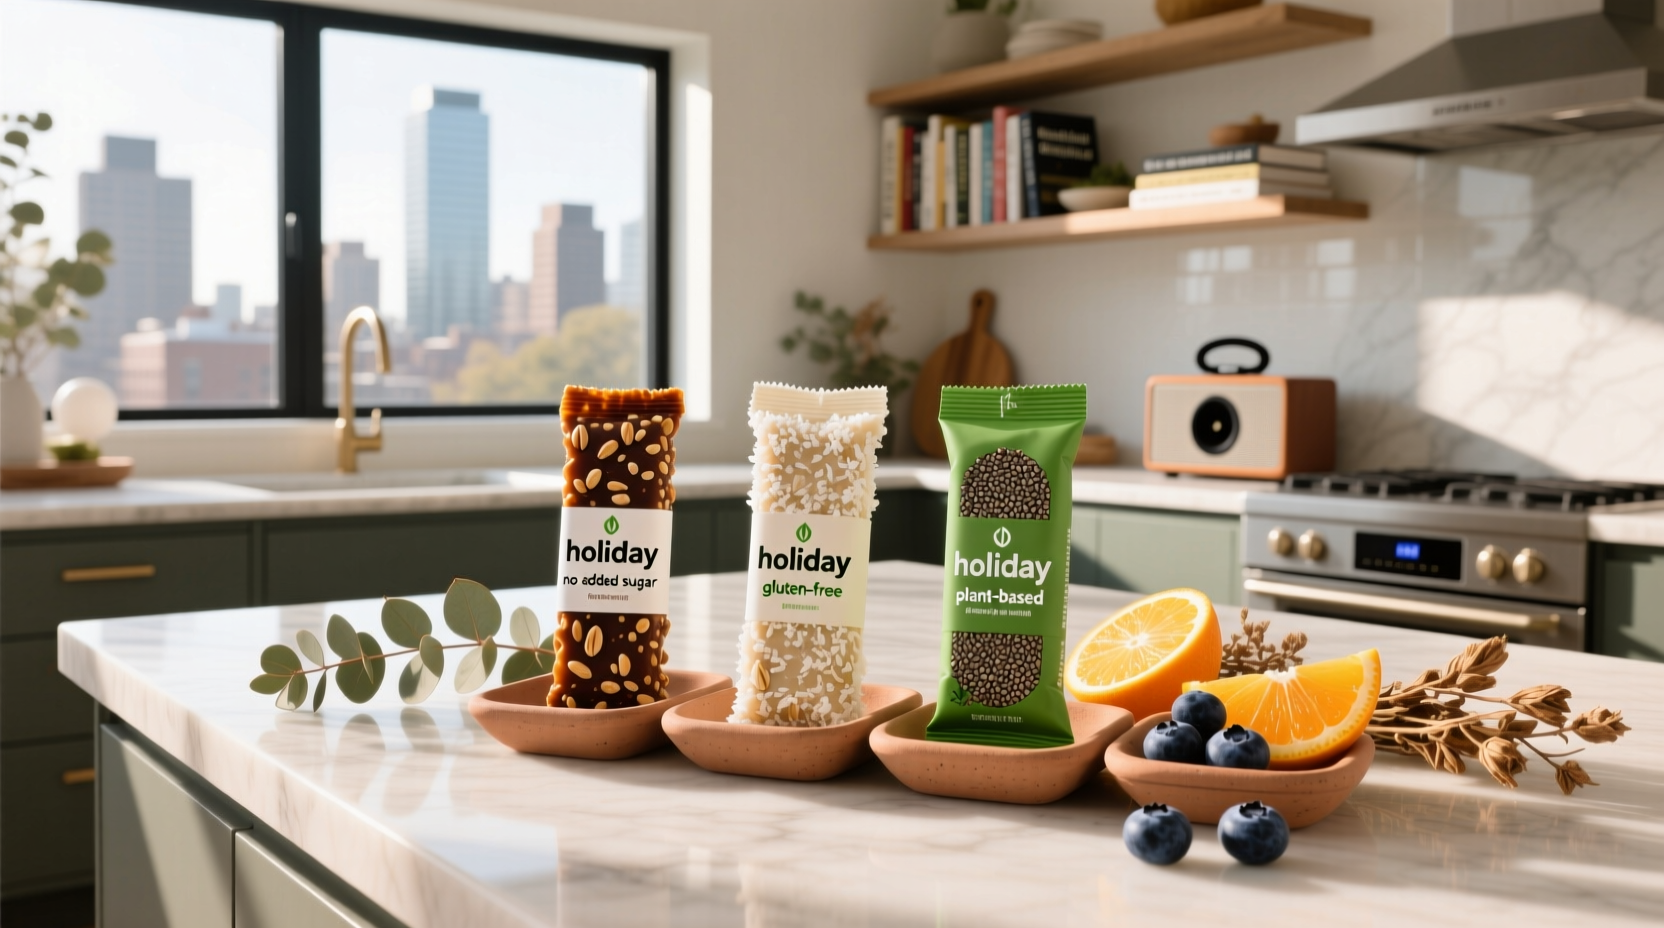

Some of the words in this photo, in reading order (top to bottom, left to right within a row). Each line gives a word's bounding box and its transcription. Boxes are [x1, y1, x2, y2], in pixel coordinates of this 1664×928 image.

[566, 539, 659, 570] holiday
[758, 545, 852, 579] holiday
[954, 550, 1052, 585] holiday
[563, 576, 578, 585] no
[582, 573, 619, 586] added
[622, 577, 658, 591] sugar
[762, 580, 843, 597] gluten-free
[956, 587, 1044, 605] plant-based
